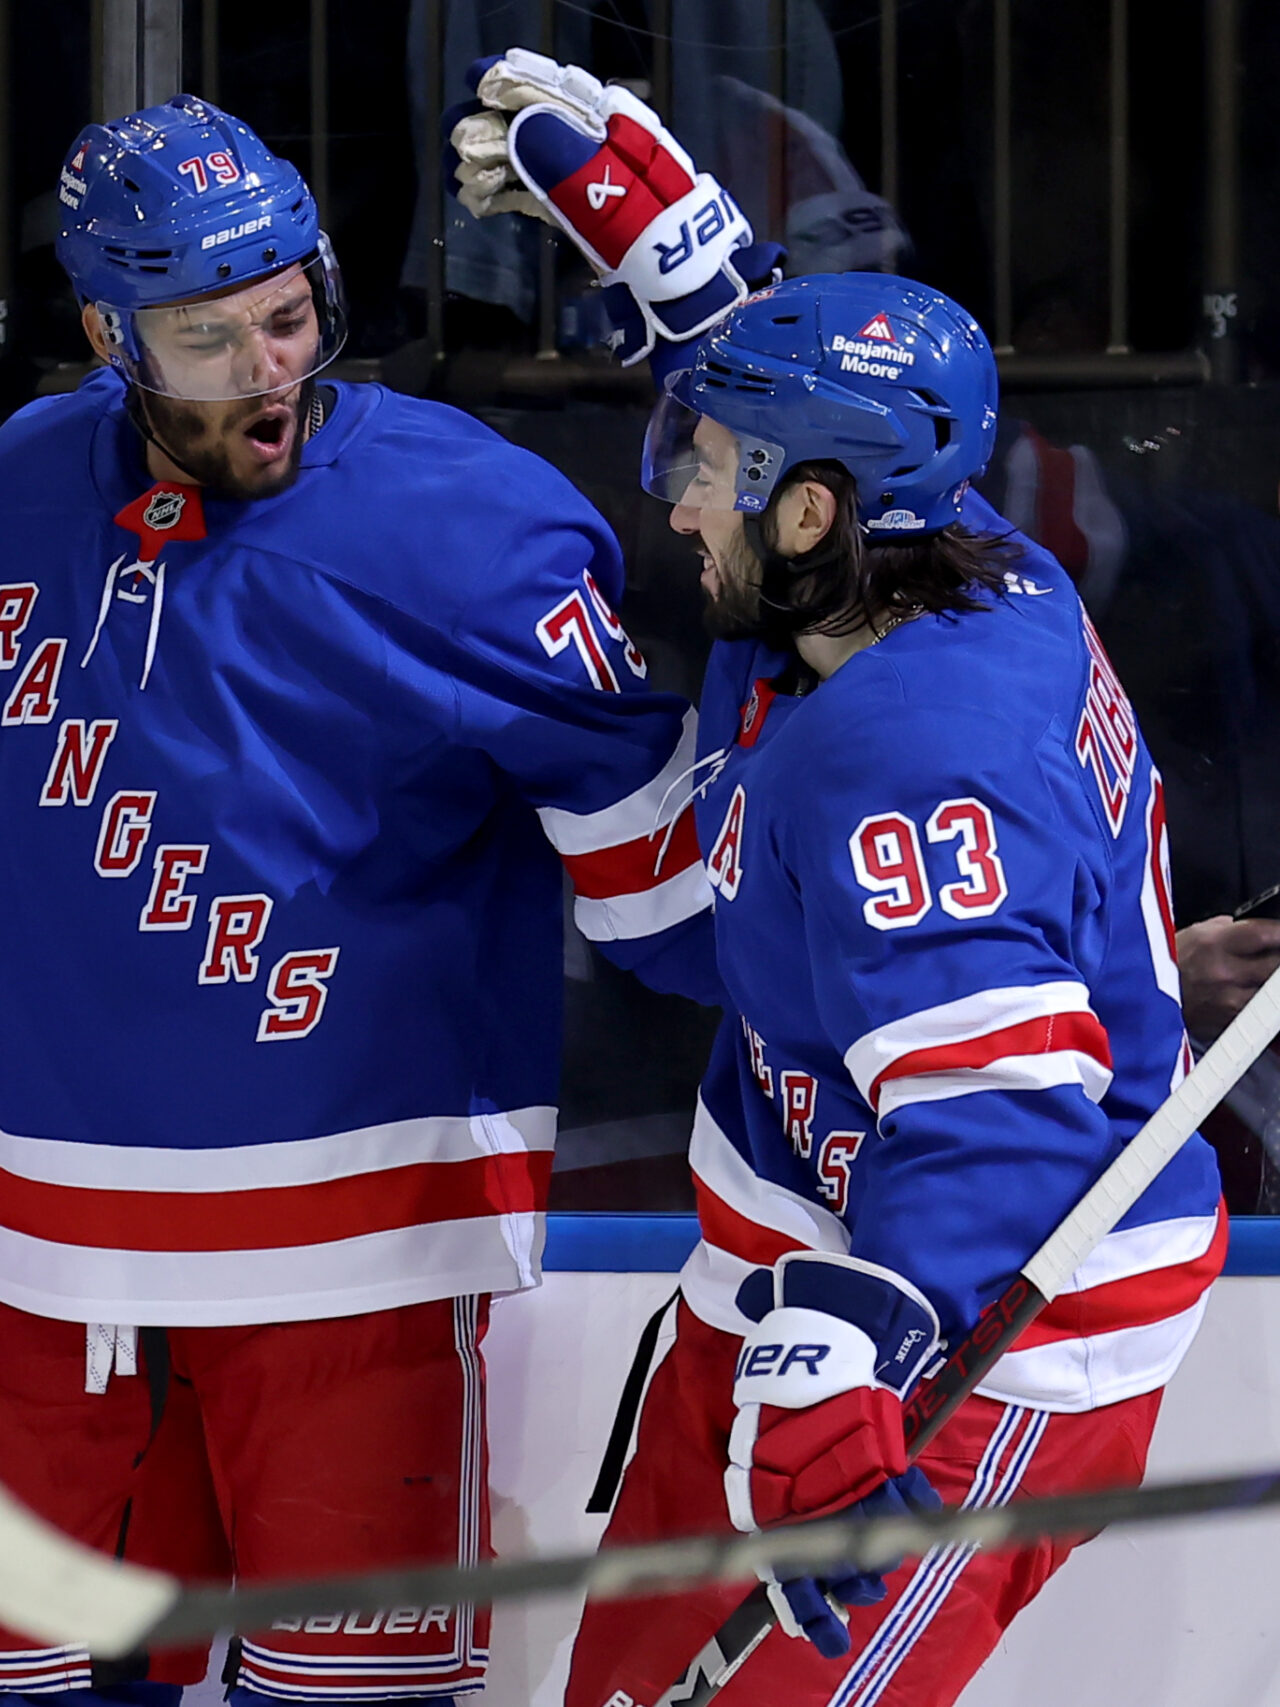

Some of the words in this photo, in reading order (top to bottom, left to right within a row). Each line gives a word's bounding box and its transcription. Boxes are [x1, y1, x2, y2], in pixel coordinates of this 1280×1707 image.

[178, 152, 240, 193] 79
[201, 216, 272, 250] BAUER
[831, 335, 915, 366] Benjamin
[840, 354, 900, 380] Moore
[847, 797, 1009, 931] 93
[894, 1329, 927, 1364] MIKA
